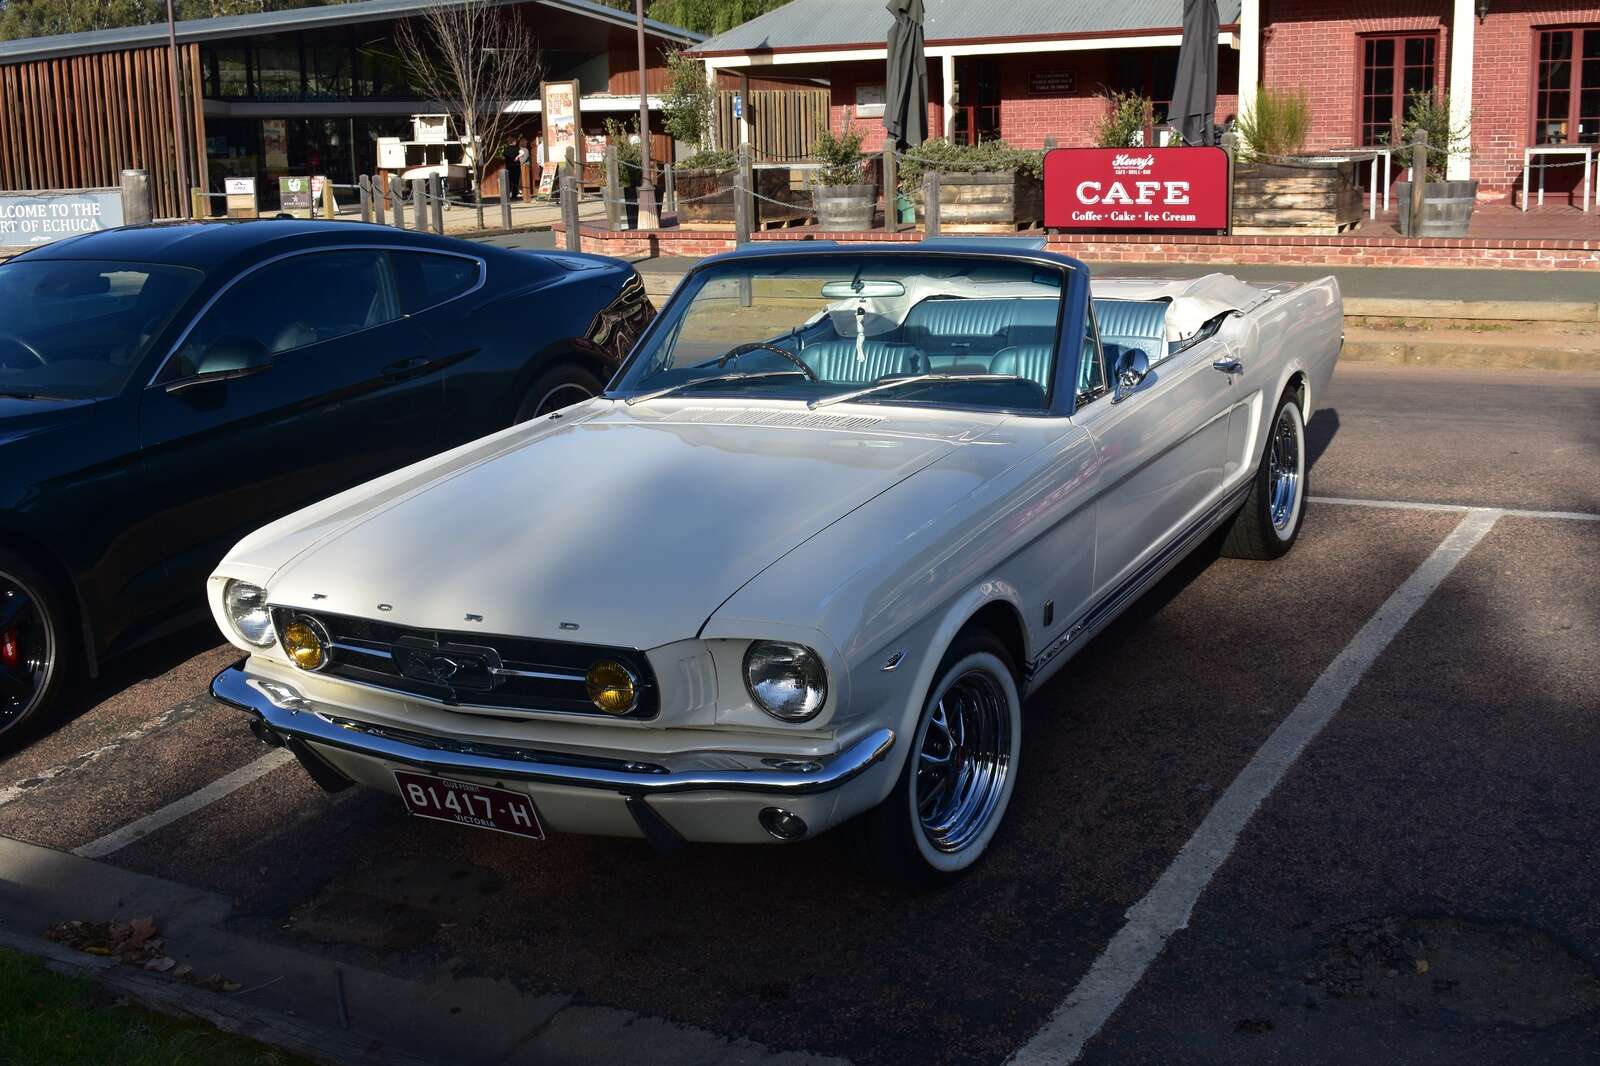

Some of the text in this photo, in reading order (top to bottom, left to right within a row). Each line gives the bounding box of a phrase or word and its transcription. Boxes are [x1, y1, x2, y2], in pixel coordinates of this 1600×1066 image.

[1112, 153, 1155, 169] Henry's
[1076, 181, 1190, 205] CAFE
[49, 203, 69, 217] TO
[71, 202, 102, 216] THE
[1071, 211, 1196, 222] Coffee Cake Ice Cream
[0, 218, 100, 233] RT OF ECHUCA
[312, 593, 580, 631] FORD
[455, 814, 497, 828] VICTORIA
